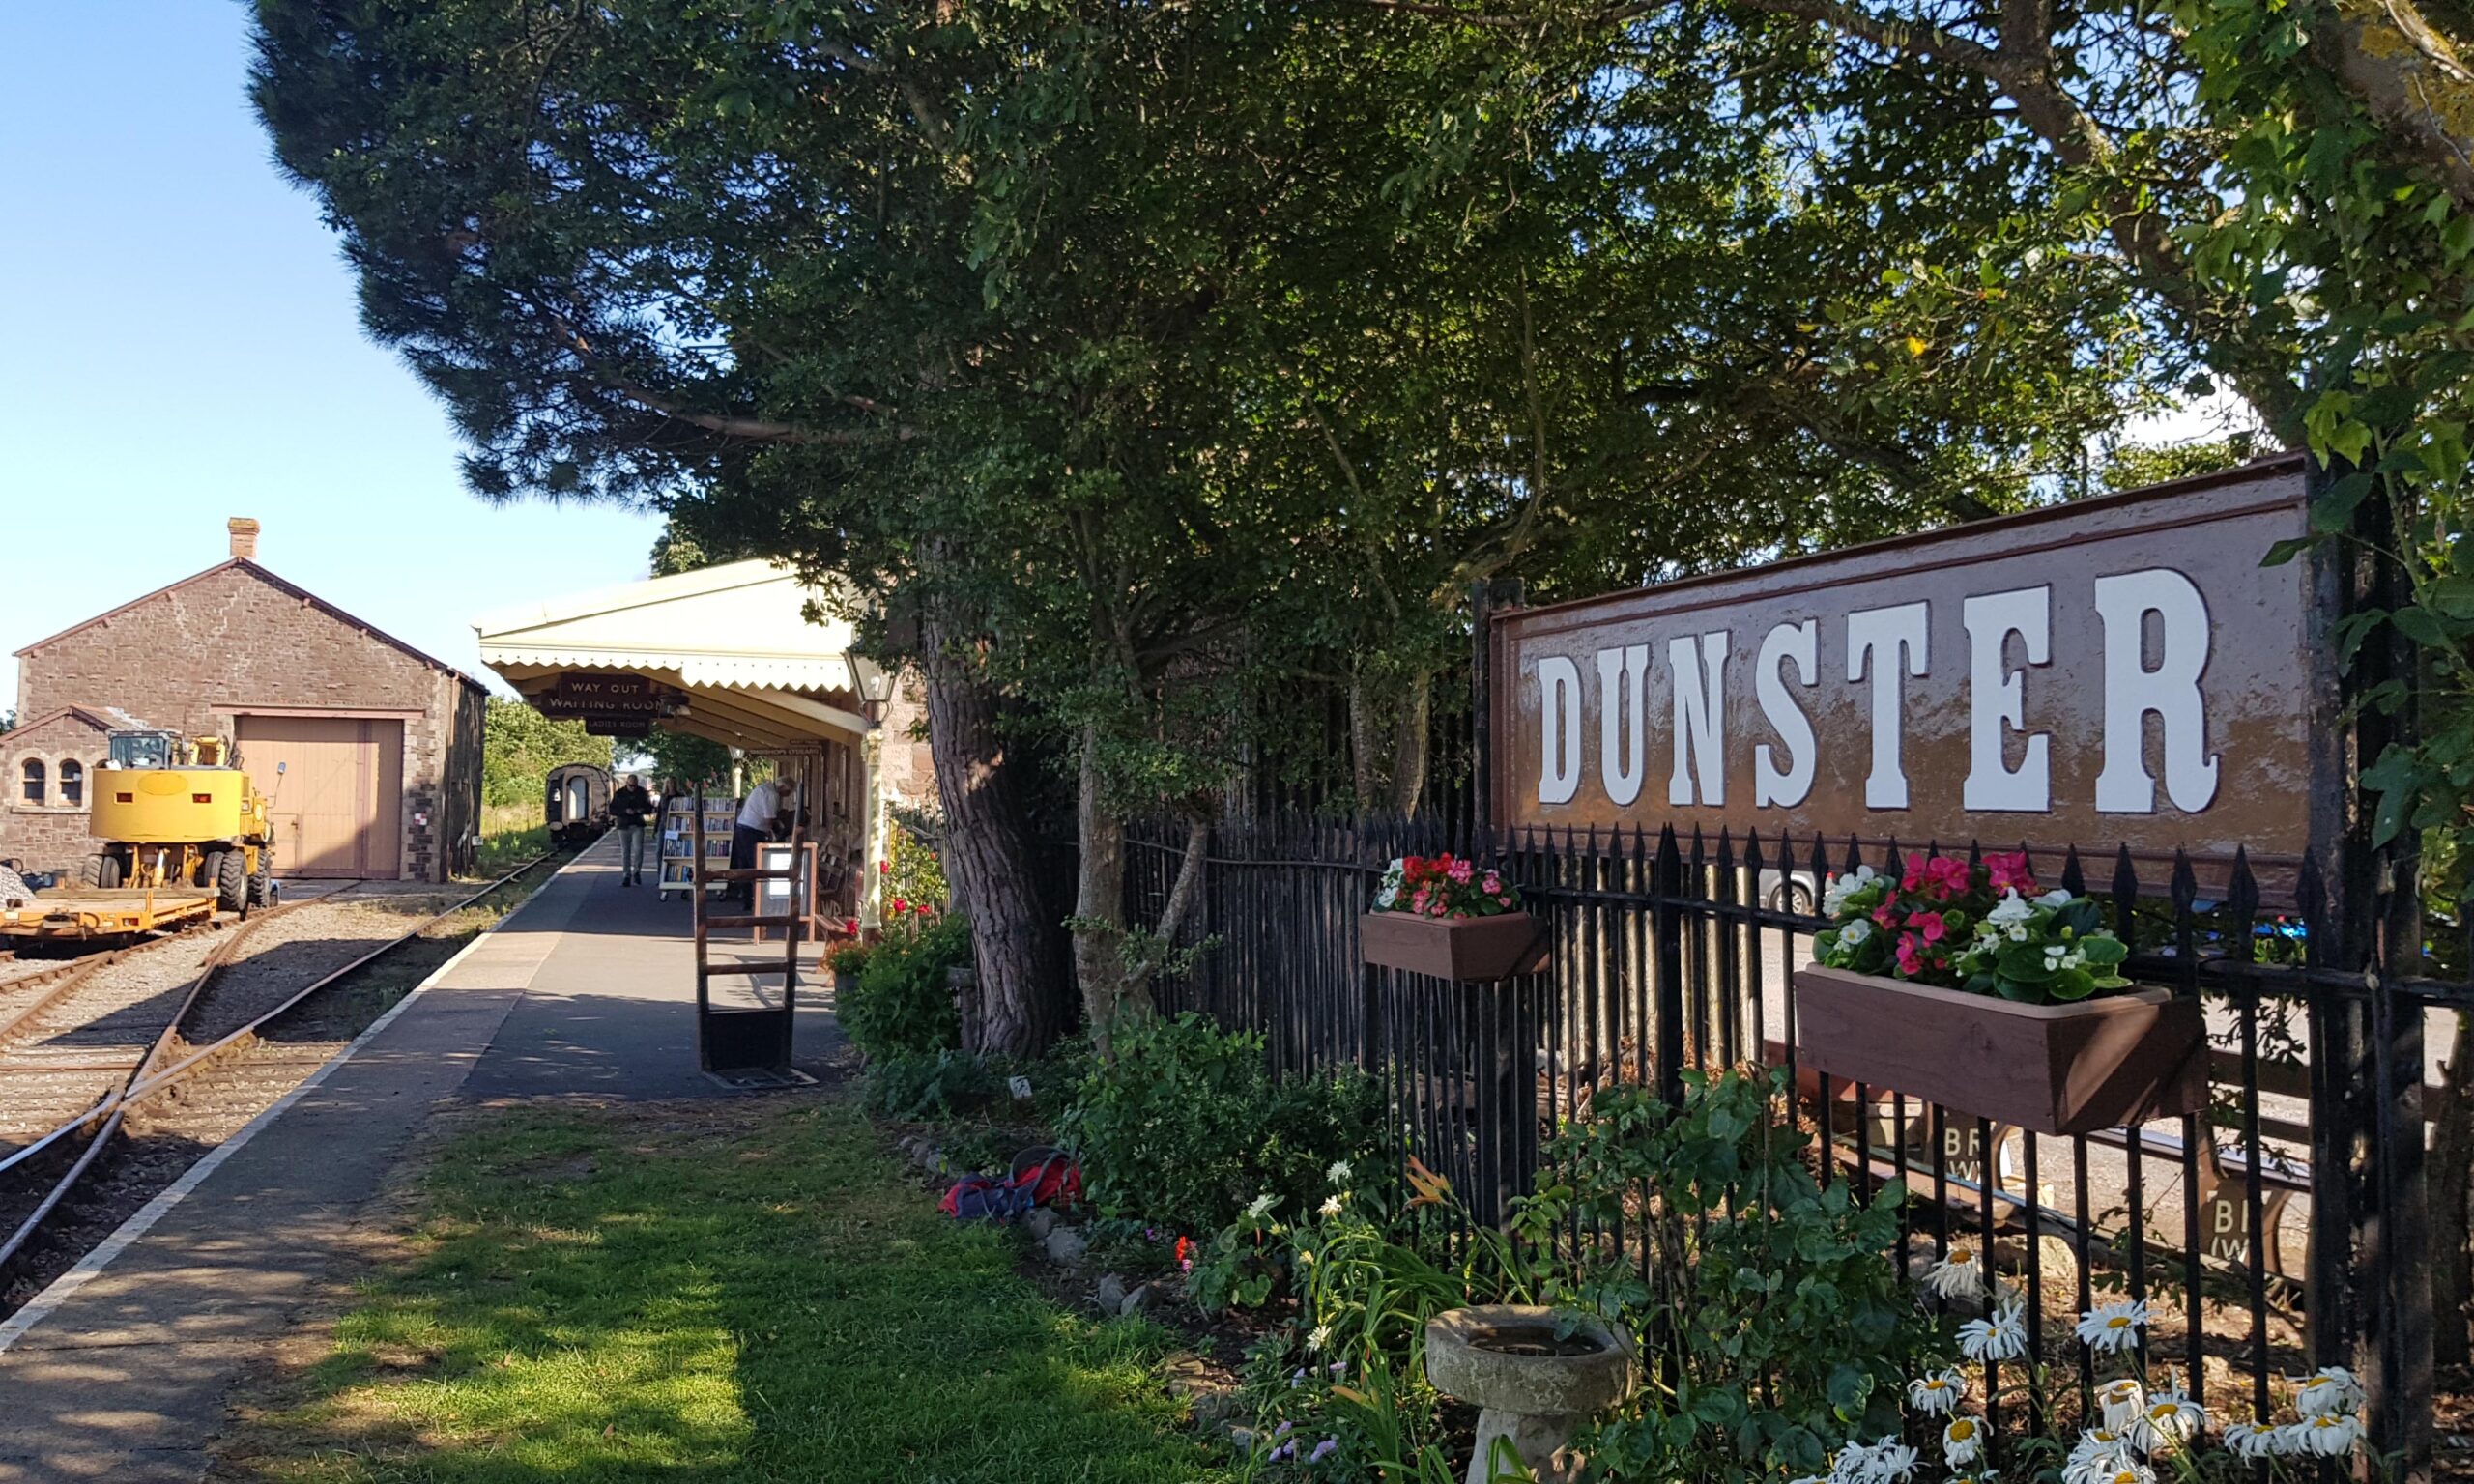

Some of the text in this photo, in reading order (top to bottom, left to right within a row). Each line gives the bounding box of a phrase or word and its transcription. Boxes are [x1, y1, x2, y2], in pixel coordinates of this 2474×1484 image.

[571, 682, 639, 694] WAY OUT
[1538, 567, 2221, 814] DUNSTER
